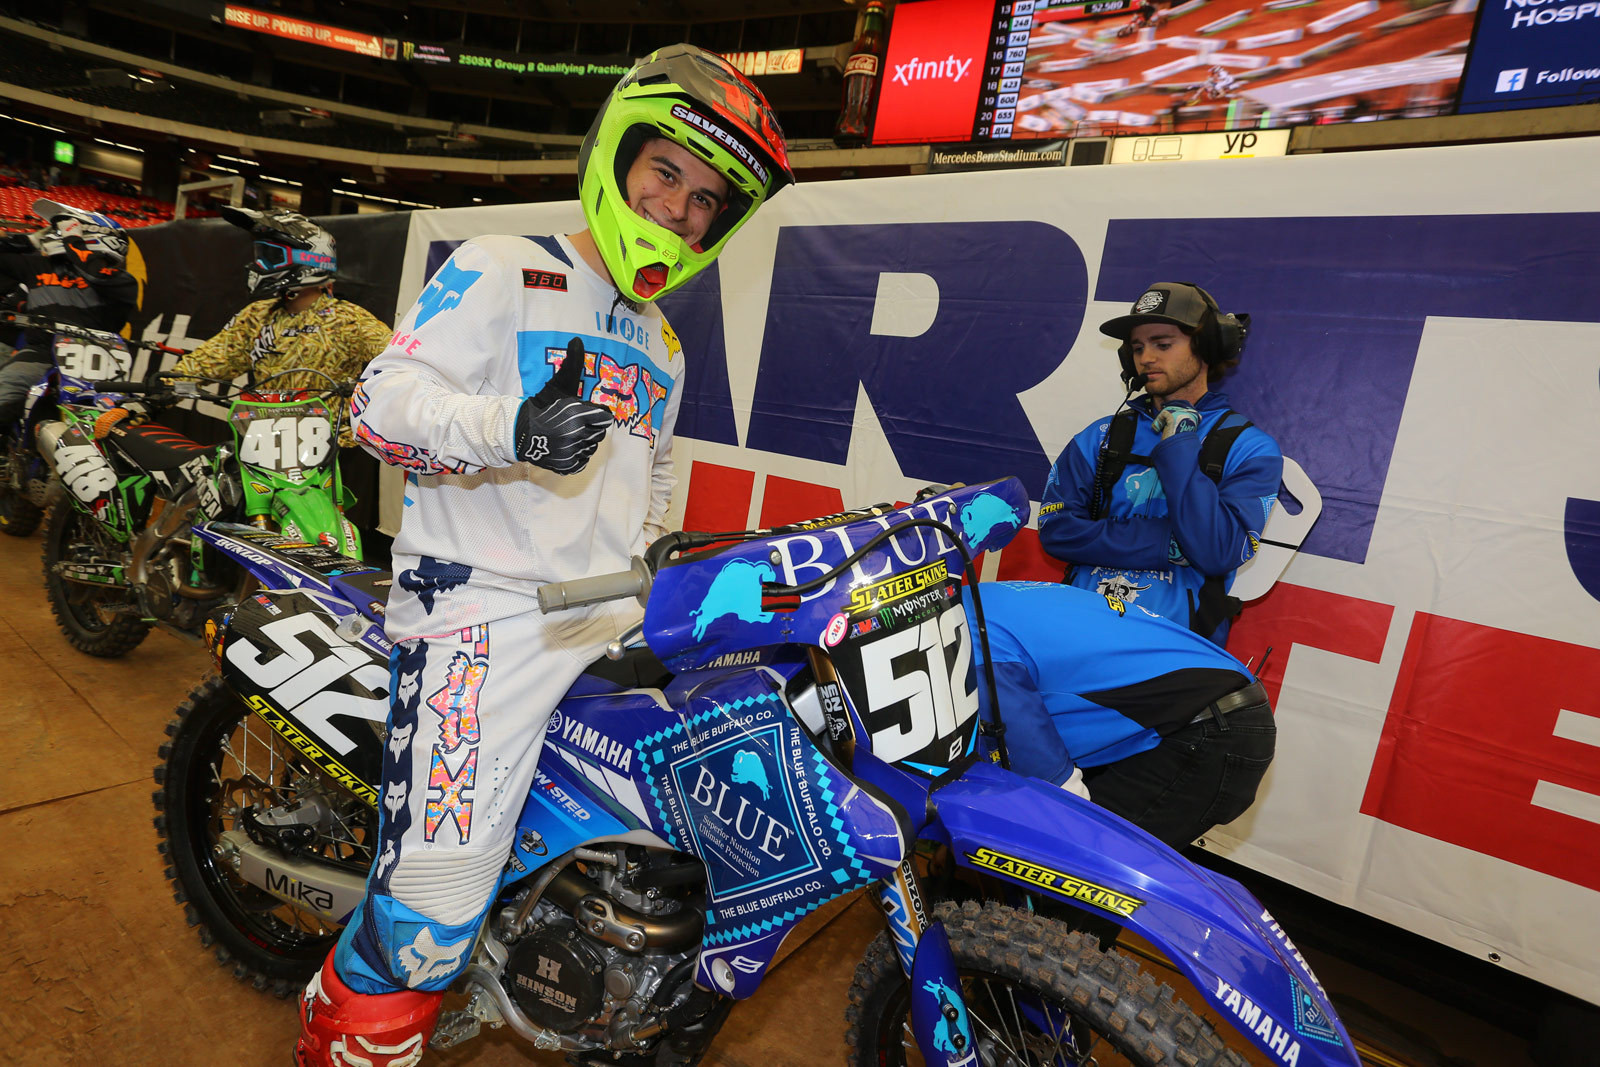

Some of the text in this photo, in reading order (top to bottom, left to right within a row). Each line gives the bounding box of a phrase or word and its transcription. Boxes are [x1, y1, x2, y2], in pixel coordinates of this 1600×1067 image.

[225, 8, 332, 43] RISE UP. POWER UP.
[998, 21, 1008, 30] 14
[1001, 6, 1011, 14] 13
[992, 49, 1024, 60] 16 760
[995, 34, 1027, 45] 15 749
[458, 54, 631, 75] 250SX Group B Qualifying Practice
[891, 54, 973, 86] xfinity
[990, 66, 1000, 75] 17
[984, 96, 995, 106] 19
[987, 80, 1018, 90] 18 423
[979, 126, 989, 136] 21
[981, 111, 993, 121] 20
[671, 105, 768, 185] SILVERSTEIN
[933, 149, 1062, 164] MercedesBenzStadium.com
[1223, 131, 1258, 154] yp
[526, 272, 566, 288] 360
[595, 311, 651, 351] IMAGE
[240, 417, 331, 470] 418
[54, 445, 118, 502] 418
[215, 538, 273, 567] DUNLOP
[766, 496, 962, 603] BLUE
[851, 562, 949, 606] SLATER SKINS
[892, 589, 943, 618] MONSTER
[907, 605, 942, 624] ENERGY
[226, 611, 391, 757] 512
[860, 603, 979, 764] 512
[563, 715, 633, 773] YAMAHA
[672, 710, 775, 754] THE BLUE BUFFALO CO.
[249, 695, 380, 810] SLATER SKIN
[534, 768, 591, 820] WISTED
[661, 774, 671, 795] THE
[668, 797, 682, 826] BLUE
[690, 765, 790, 862] BLUE
[790, 727, 832, 860] THE BLUE BUFFALO CO.
[699, 823, 761, 878] Ultimate Protection
[702, 814, 761, 866] Superior Nutrition
[265, 867, 334, 912] Mika
[719, 880, 825, 920] THE BLUE BUFFALO CO.
[975, 847, 1138, 917] SLATER SKINS
[516, 973, 577, 1008] HINSON
[1216, 976, 1301, 1067] YAMAHA
